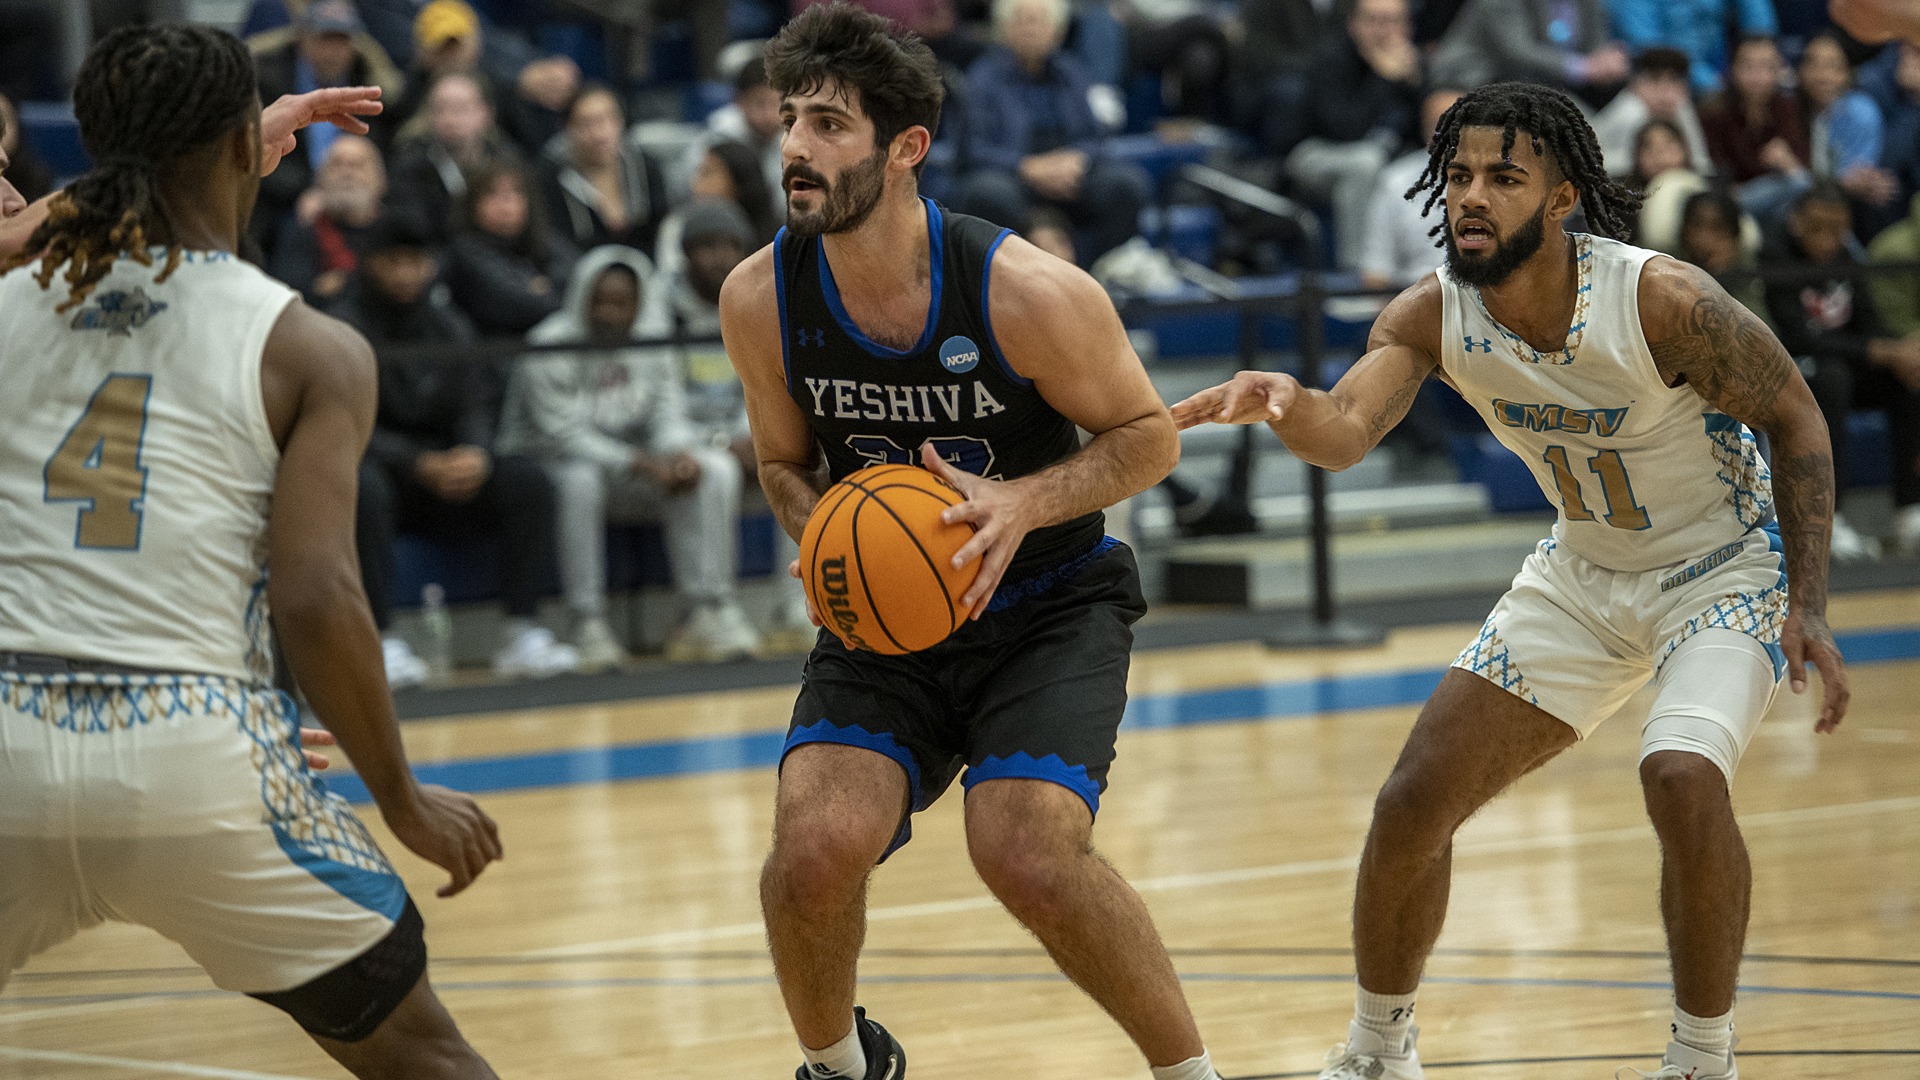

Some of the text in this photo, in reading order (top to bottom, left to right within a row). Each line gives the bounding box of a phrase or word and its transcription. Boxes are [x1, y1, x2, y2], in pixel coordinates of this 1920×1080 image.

[946, 351, 978, 366] NCAA
[805, 378, 1005, 422] YESHIVA
[1492, 399, 1629, 437] CMSV
[43, 371, 153, 552] 4
[1543, 445, 1652, 530] 11
[1661, 541, 1744, 592] DOLPHINS
